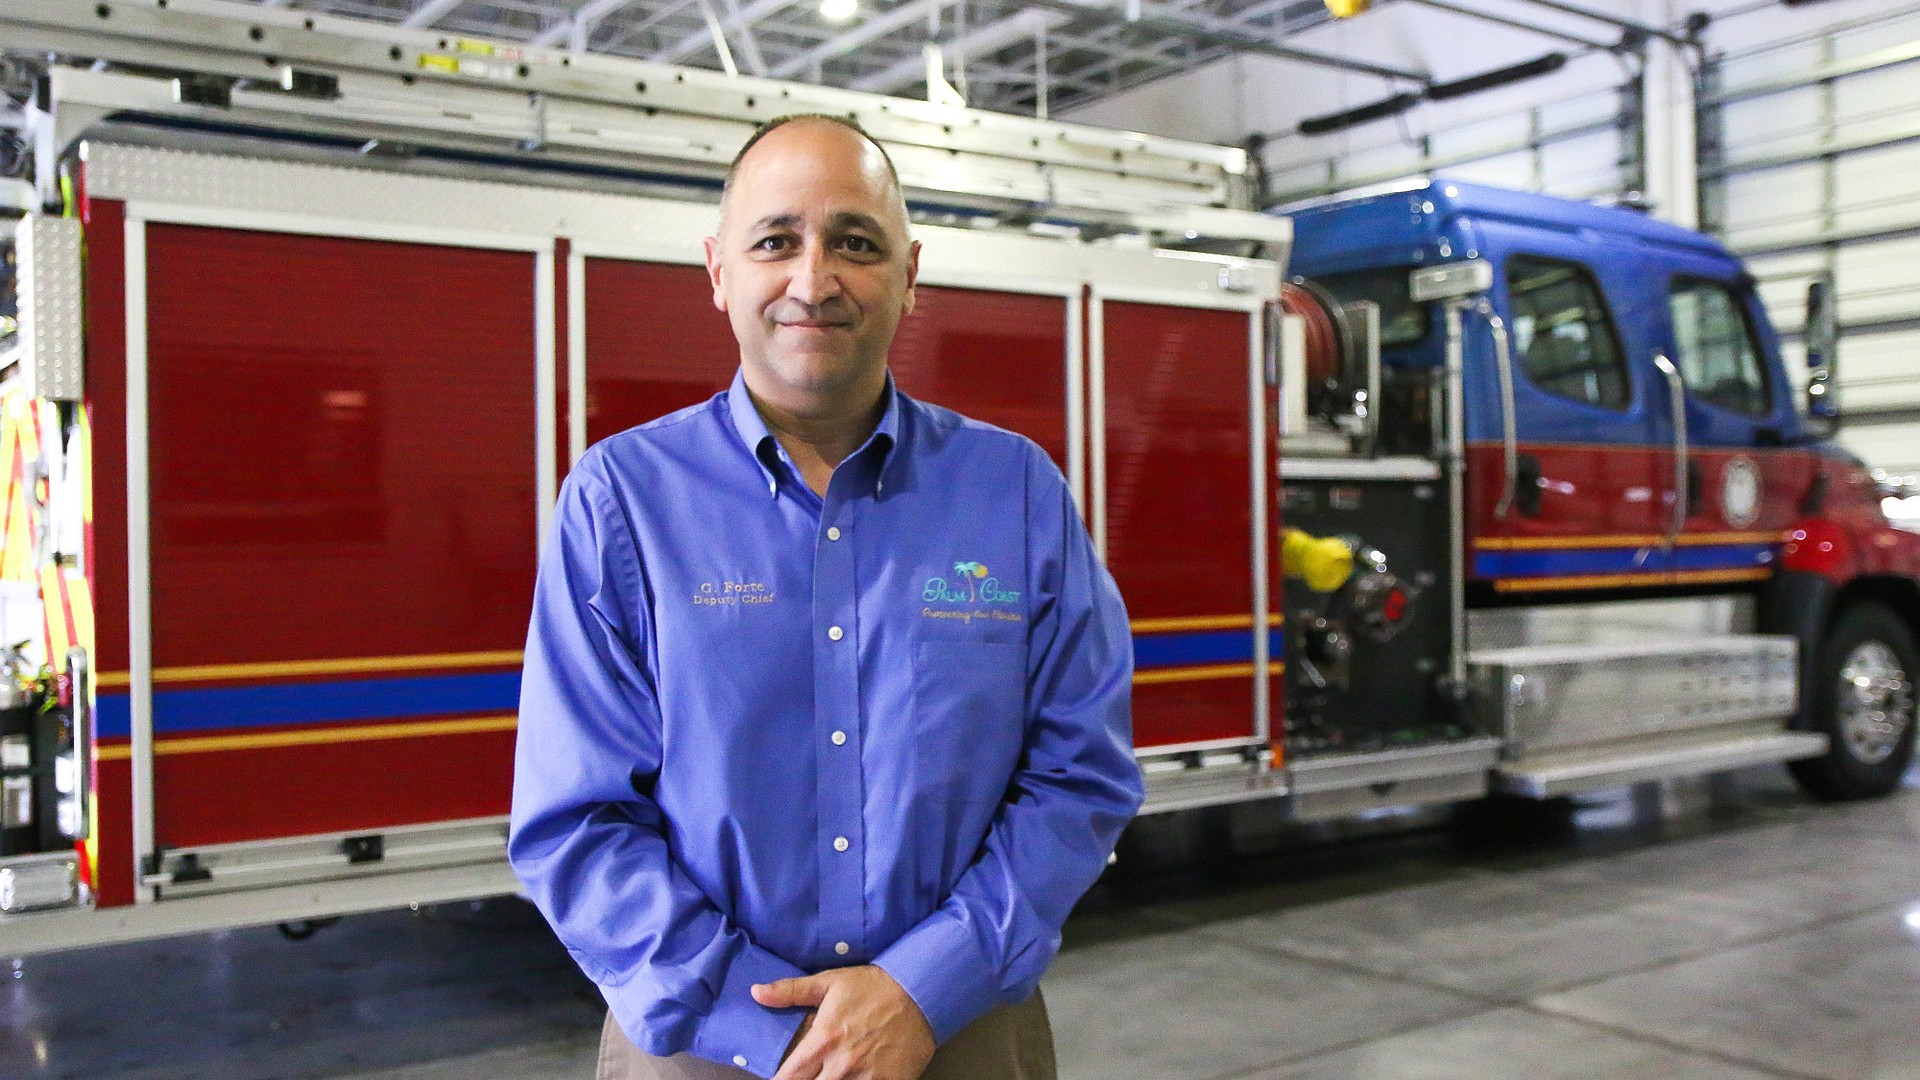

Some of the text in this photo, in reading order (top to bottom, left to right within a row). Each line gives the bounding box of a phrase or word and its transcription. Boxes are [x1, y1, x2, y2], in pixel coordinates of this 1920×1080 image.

[700, 581, 765, 594] G. Forte
[693, 592, 775, 606] Deputy Chief
